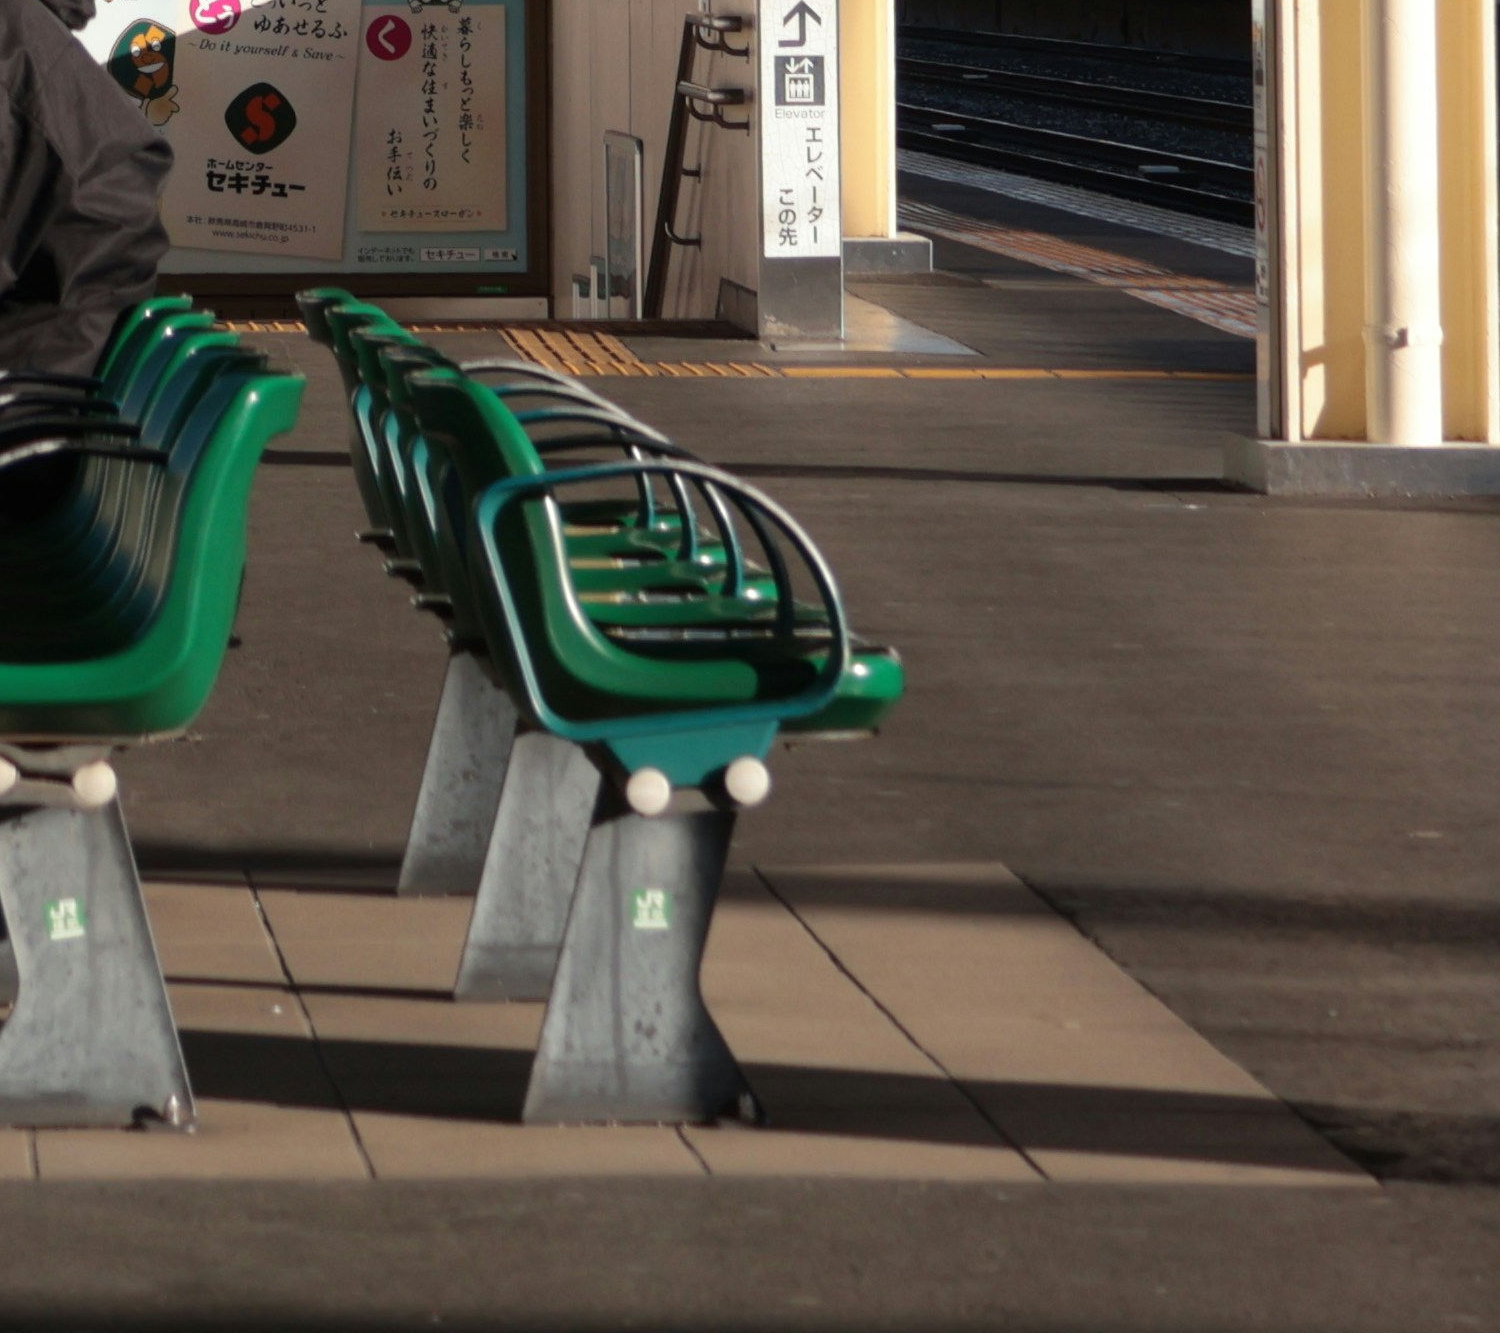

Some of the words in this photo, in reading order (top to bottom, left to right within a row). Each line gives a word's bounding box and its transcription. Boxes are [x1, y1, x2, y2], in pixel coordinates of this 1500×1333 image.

[254, 14, 349, 40] ゆあせるふ
[377, 19, 396, 54] く
[220, 39, 232, 52] it
[235, 40, 290, 58] yourself
[291, 49, 299, 58] &
[457, 16, 474, 164] 暮らしもっと楽しく
[421, 24, 439, 191] 快適な住まいづくりの
[774, 108, 825, 119] Elevator
[206, 158, 274, 173] ホームセンター
[386, 129, 402, 196] お手伝い
[206, 170, 306, 198] セキチュー
[805, 126, 824, 245] エレベーター
[390, 208, 476, 219] セキチュースローガン
[778, 188, 798, 247] この先
[425, 249, 476, 261] セキチュー
